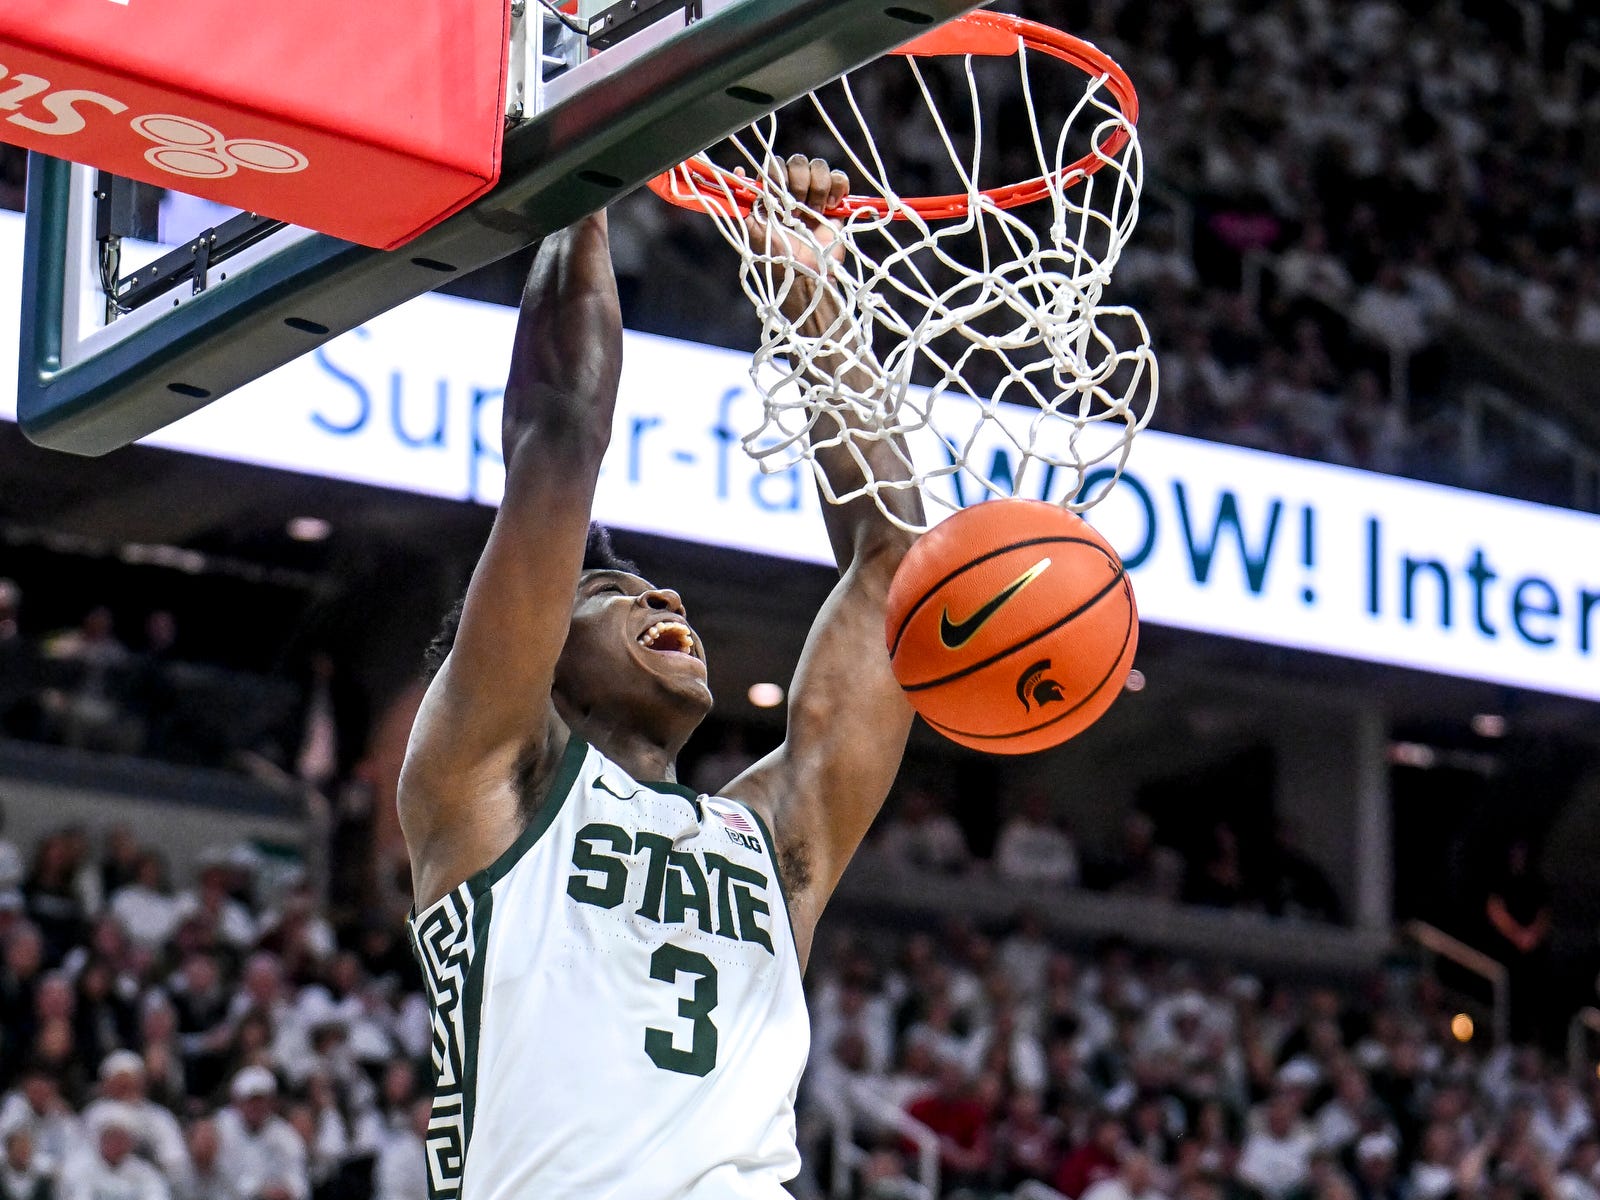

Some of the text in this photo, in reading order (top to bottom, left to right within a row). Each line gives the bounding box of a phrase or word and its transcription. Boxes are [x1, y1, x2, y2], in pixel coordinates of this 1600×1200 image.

[1369, 517, 1600, 652] Inter
[567, 823, 775, 956] STATE
[645, 943, 718, 1077] 3
